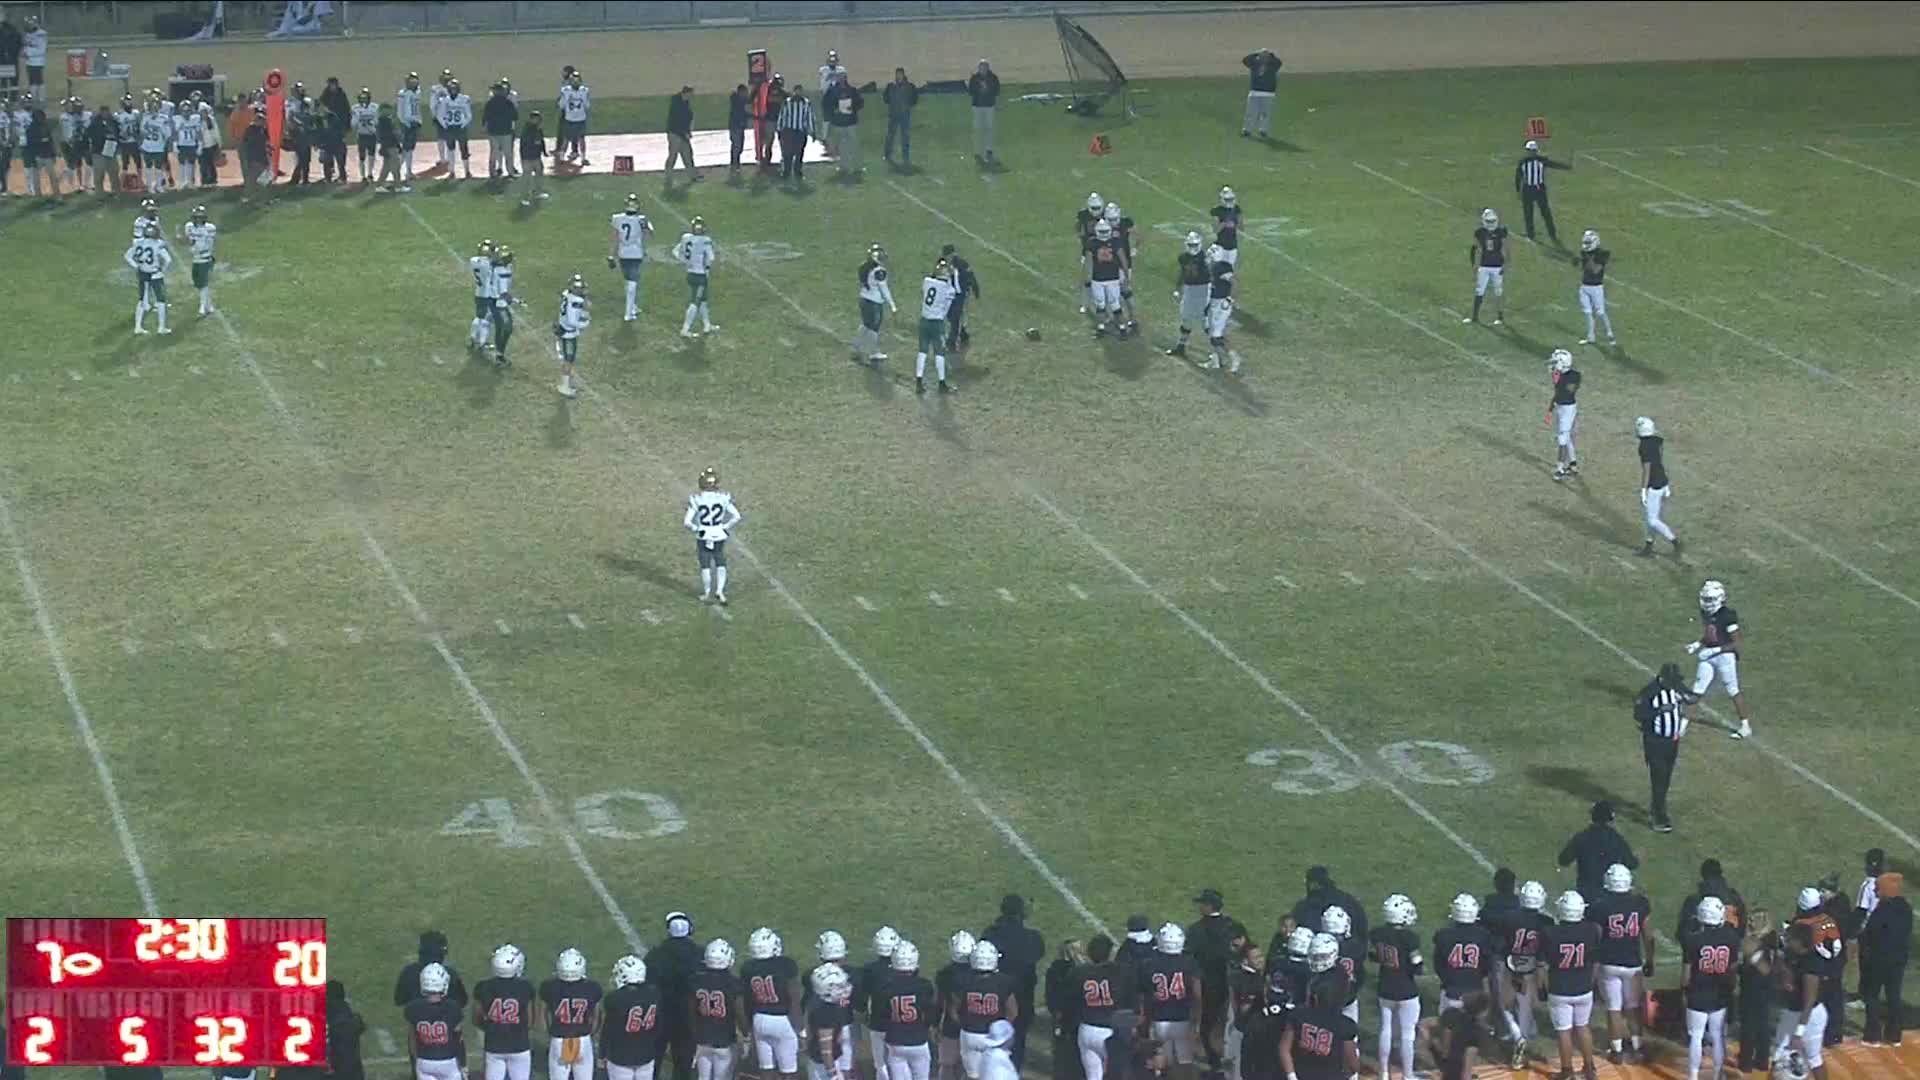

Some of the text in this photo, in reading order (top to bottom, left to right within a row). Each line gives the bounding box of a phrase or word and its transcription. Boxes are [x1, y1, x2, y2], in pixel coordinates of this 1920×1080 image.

[621, 223, 631, 241] 7
[134, 246, 154, 265] 23
[925, 286, 937, 307] 8
[699, 503, 725, 527] 22
[1245, 740, 1497, 796] 30
[440, 787, 690, 848] 40
[1608, 911, 1640, 938] 54
[1447, 943, 1480, 969] 43
[1558, 943, 1585, 969] 71
[1083, 978, 1114, 1007] 21
[1152, 971, 1185, 1001] 34
[488, 998, 520, 1024] 42
[554, 998, 588, 1025] 47
[625, 1004, 657, 1033] 64
[890, 994, 918, 1022] 15
